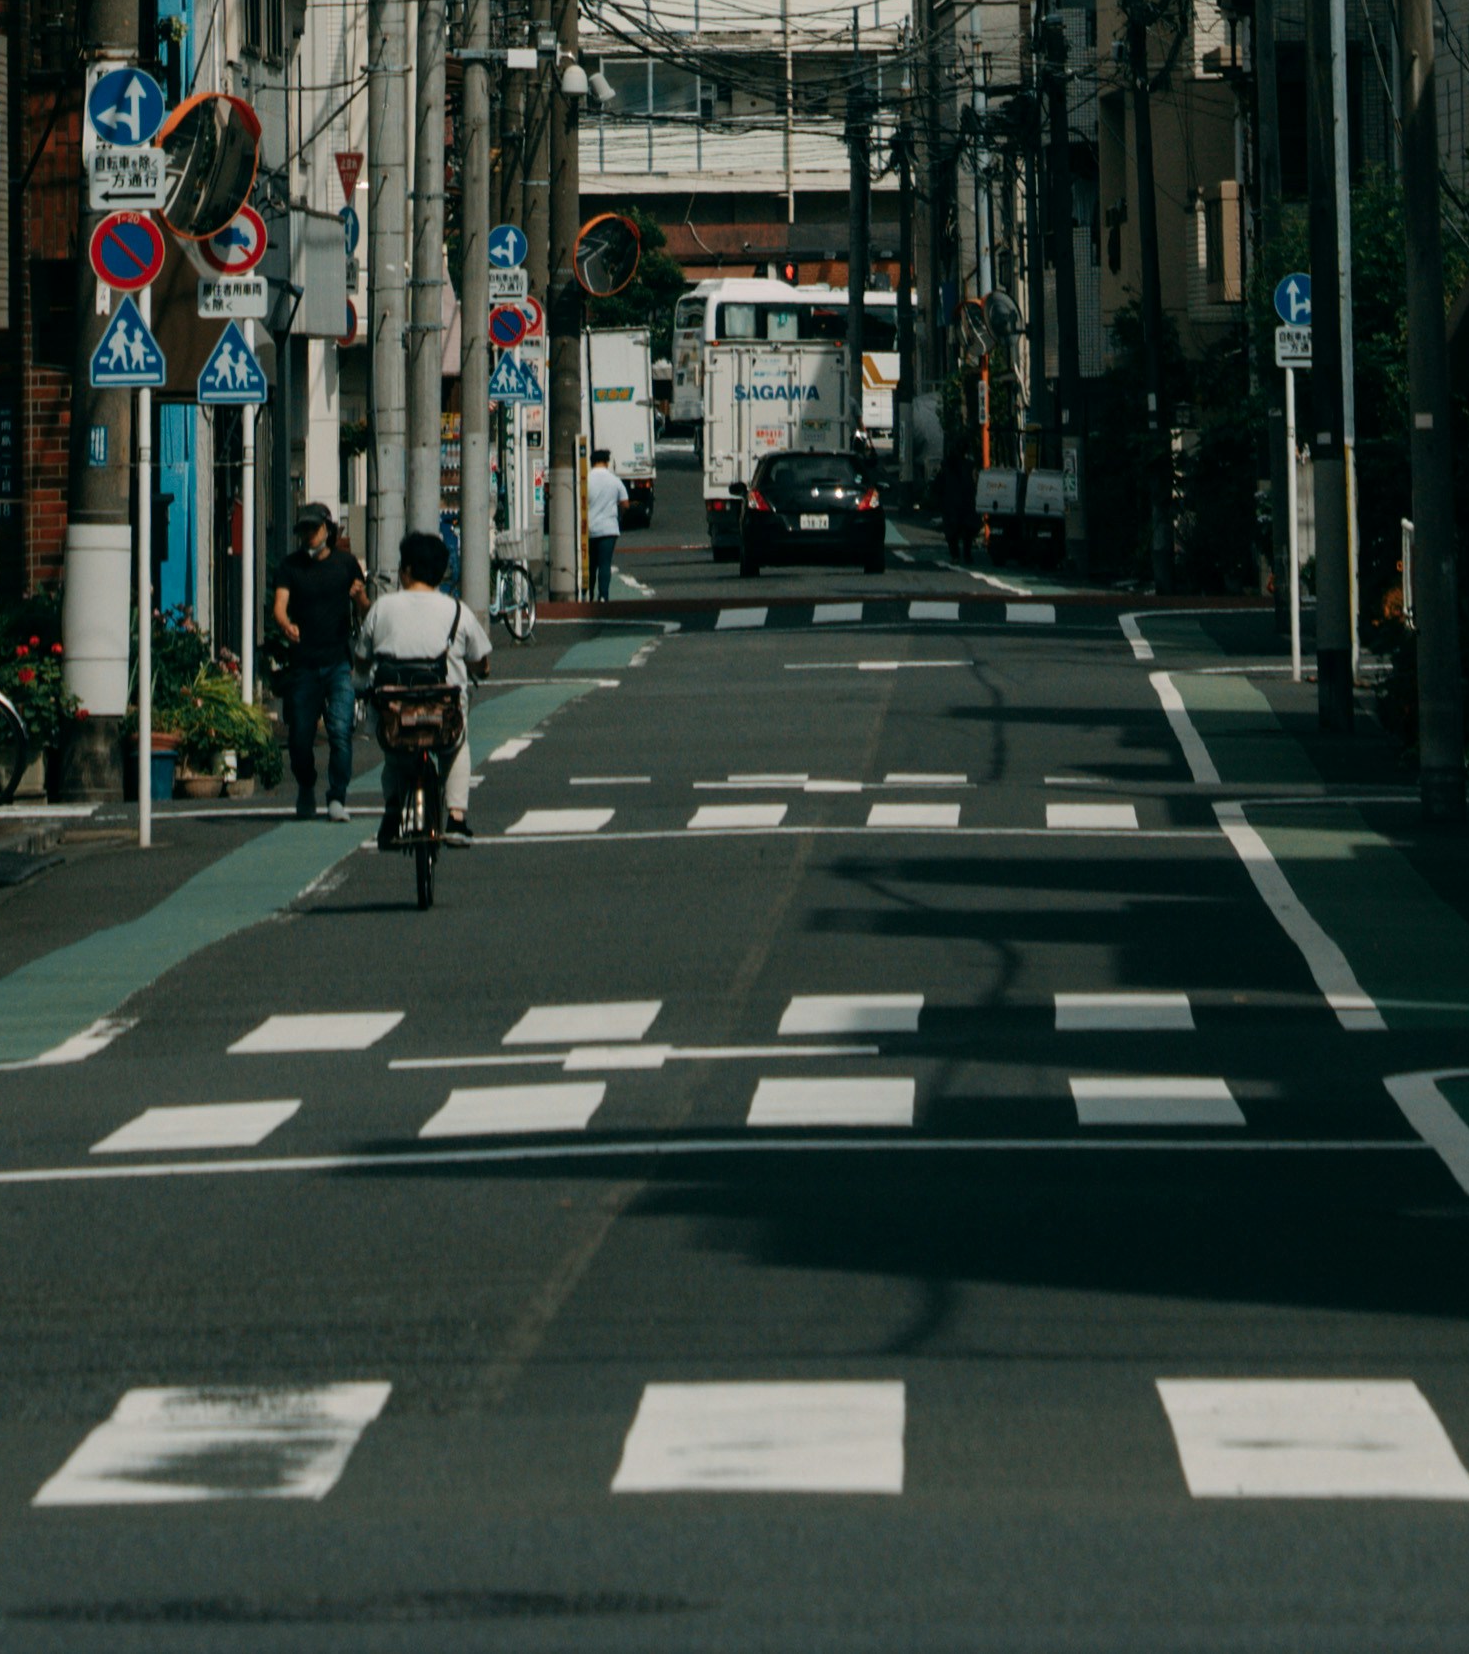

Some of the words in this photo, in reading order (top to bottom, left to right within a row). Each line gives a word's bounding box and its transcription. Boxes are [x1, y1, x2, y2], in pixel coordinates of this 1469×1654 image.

[95, 155, 158, 171] 自転車を除く
[95, 172, 158, 188] 一方通行
[734, 384, 820, 401] SAGAWA
